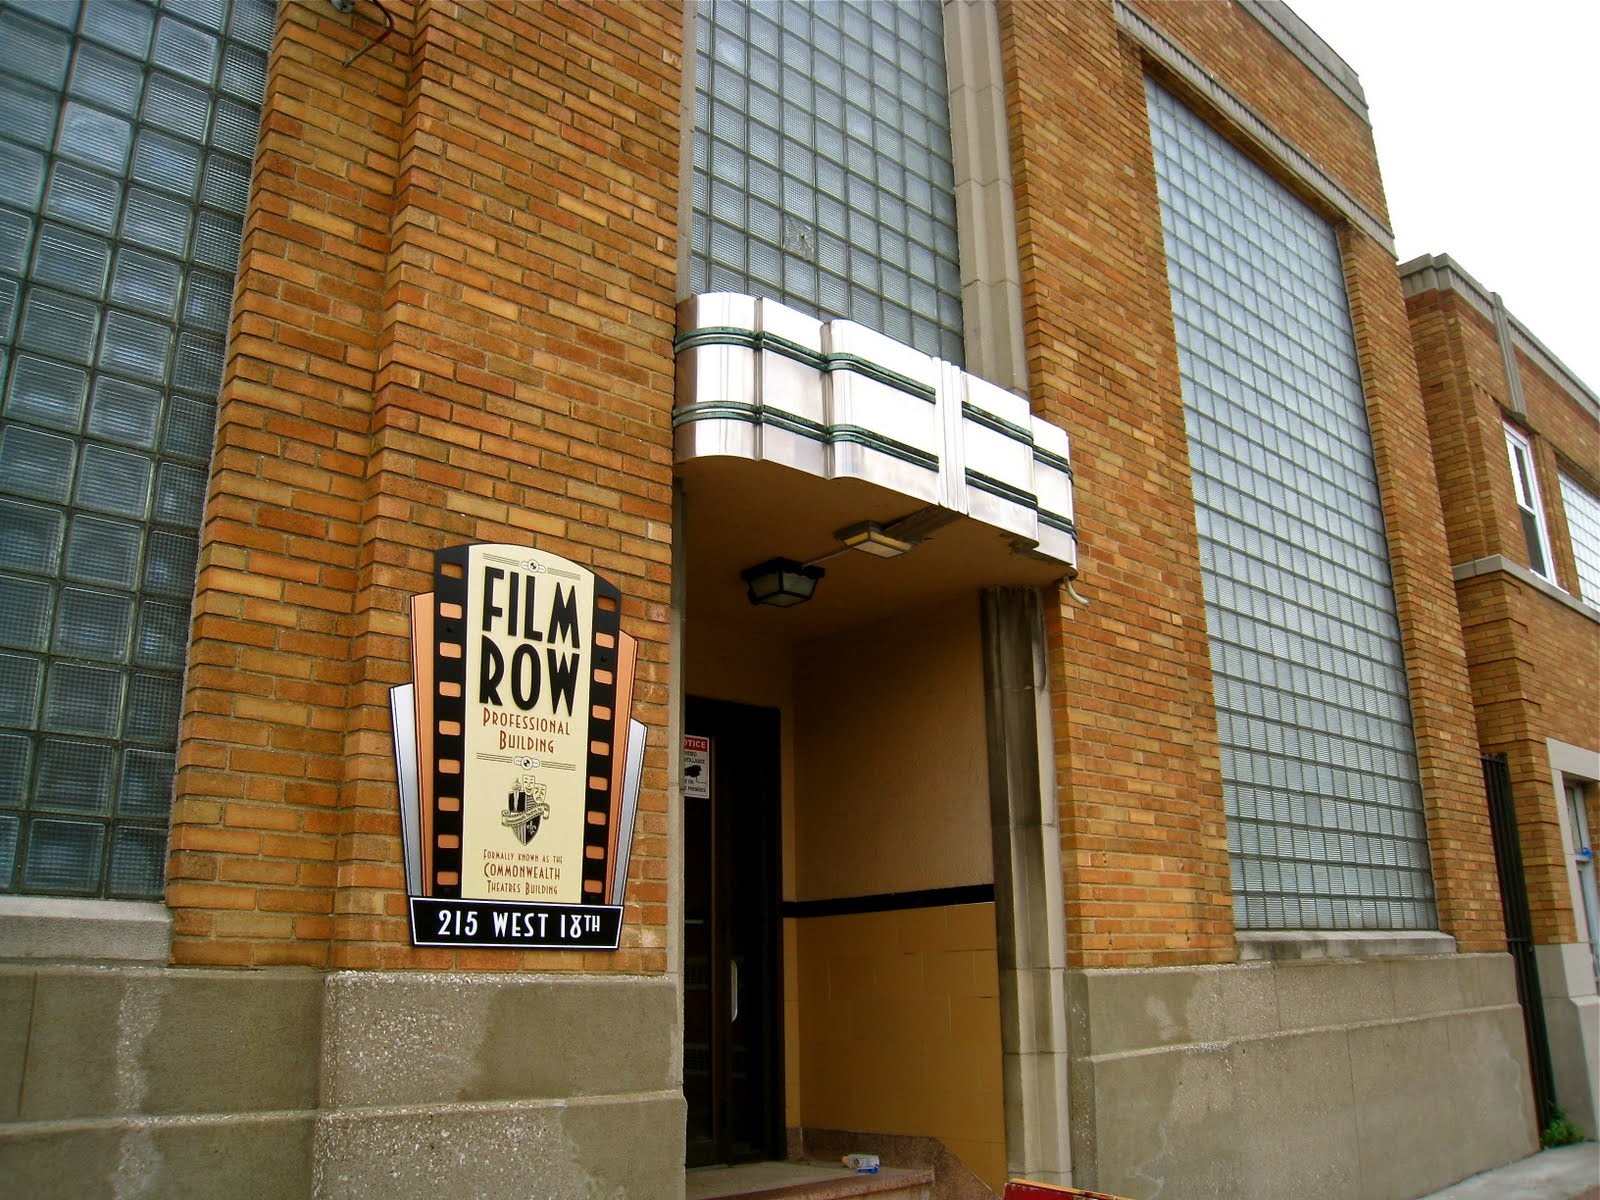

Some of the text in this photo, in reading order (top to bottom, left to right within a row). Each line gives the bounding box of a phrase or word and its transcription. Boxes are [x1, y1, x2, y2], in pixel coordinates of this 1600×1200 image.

[482, 566, 580, 649] FILM
[479, 634, 580, 717] ROW
[483, 707, 570, 736] PROFESSIONAL
[499, 730, 554, 754] BUILDING
[683, 739, 706, 749] OTICE
[483, 849, 563, 864] FORMALLY KNOWN AS THE
[483, 862, 561, 880] COMMONWEALTH
[487, 879, 558, 896] THEATRES BUILDING
[437, 909, 478, 936] 215
[492, 911, 549, 938] WEST
